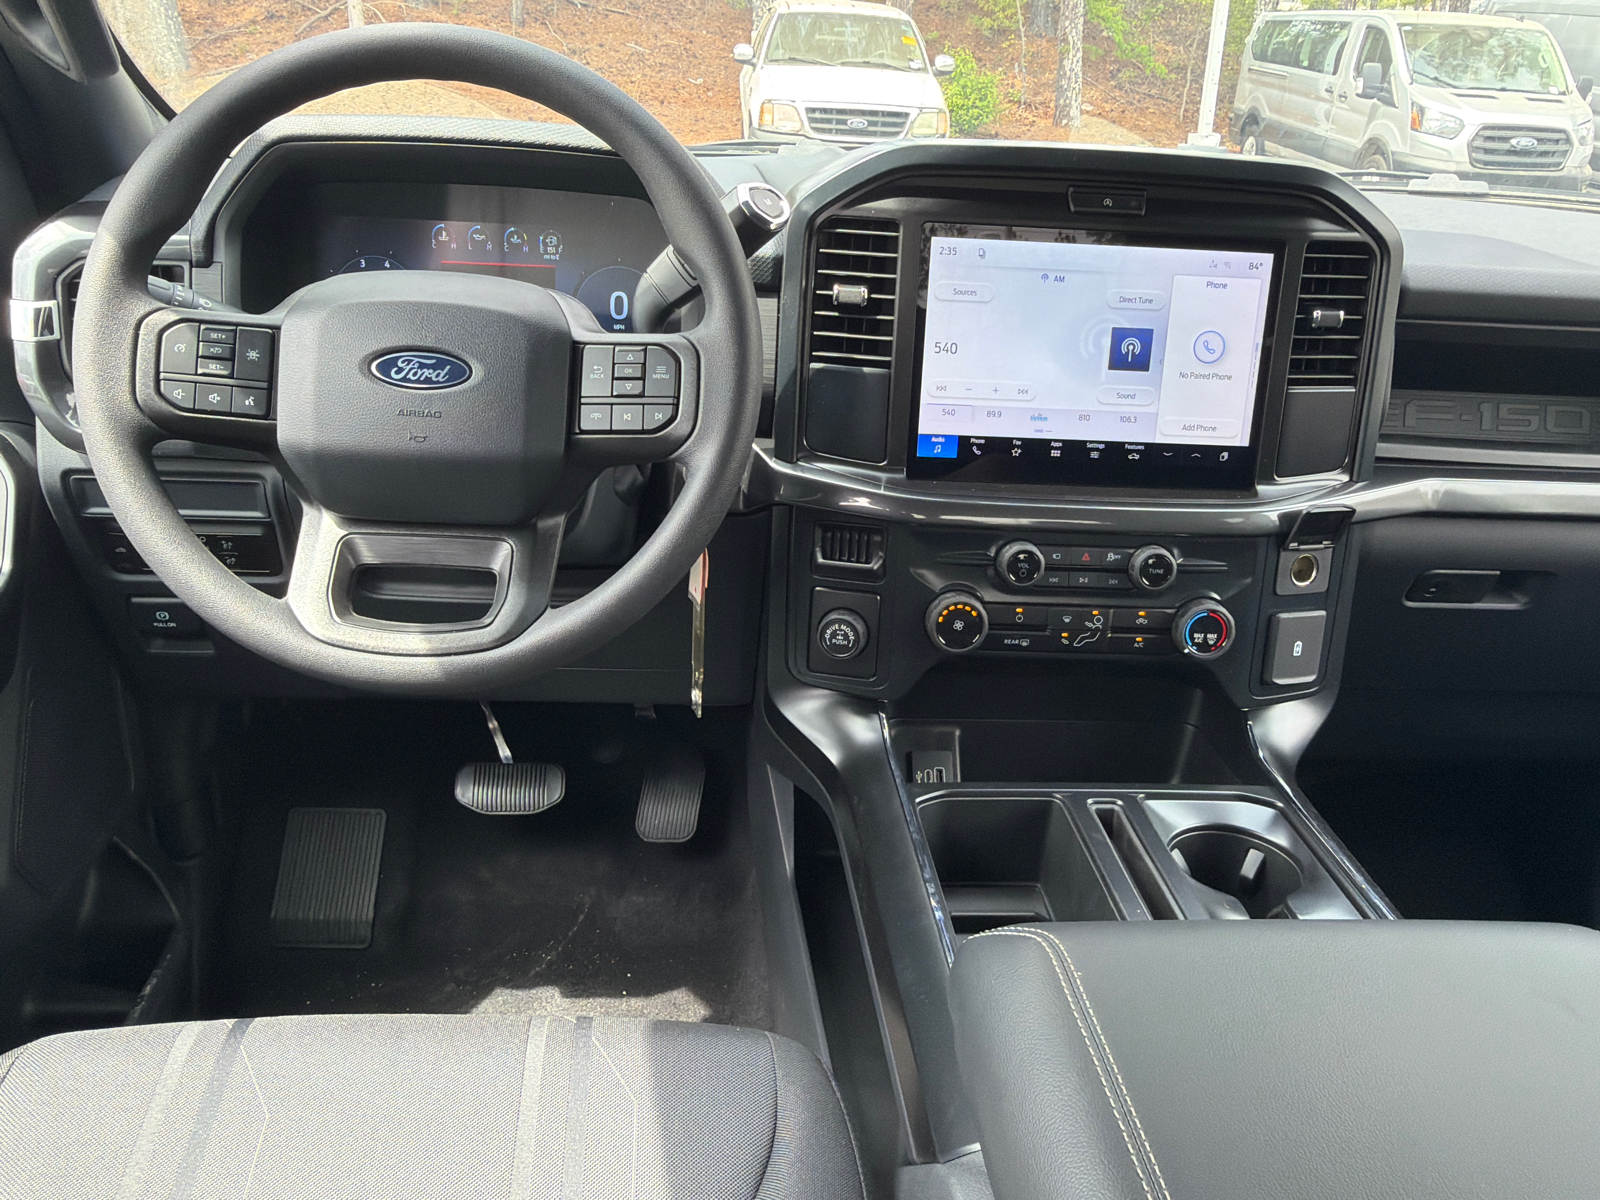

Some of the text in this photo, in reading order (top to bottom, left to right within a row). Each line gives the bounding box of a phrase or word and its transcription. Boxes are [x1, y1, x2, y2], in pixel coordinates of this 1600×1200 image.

[451, 242, 457, 250] H
[939, 246, 958, 256] 2:35
[360, 260, 366, 268] 3
[384, 260, 390, 268] 4
[1053, 275, 1066, 283] AM
[1206, 281, 1228, 290] Phone
[953, 288, 978, 297] Sources
[1119, 296, 1154, 305] Direct Tune
[609, 291, 628, 320] 0
[934, 342, 958, 355] 540
[390, 356, 451, 382] Ford
[1179, 372, 1233, 382] No Paired Phone
[1116, 392, 1136, 401] Sound
[397, 409, 442, 419] AIRBAG
[942, 409, 956, 417] 540
[986, 411, 1002, 419] 89.9
[1403, 400, 1591, 434] F-150
[1078, 414, 1091, 422] 810
[1120, 415, 1137, 424] 106.3
[1181, 424, 1218, 433] Add Phone
[1086, 442, 1106, 450] Settings
[825, 623, 855, 640] DRIVE MODE
